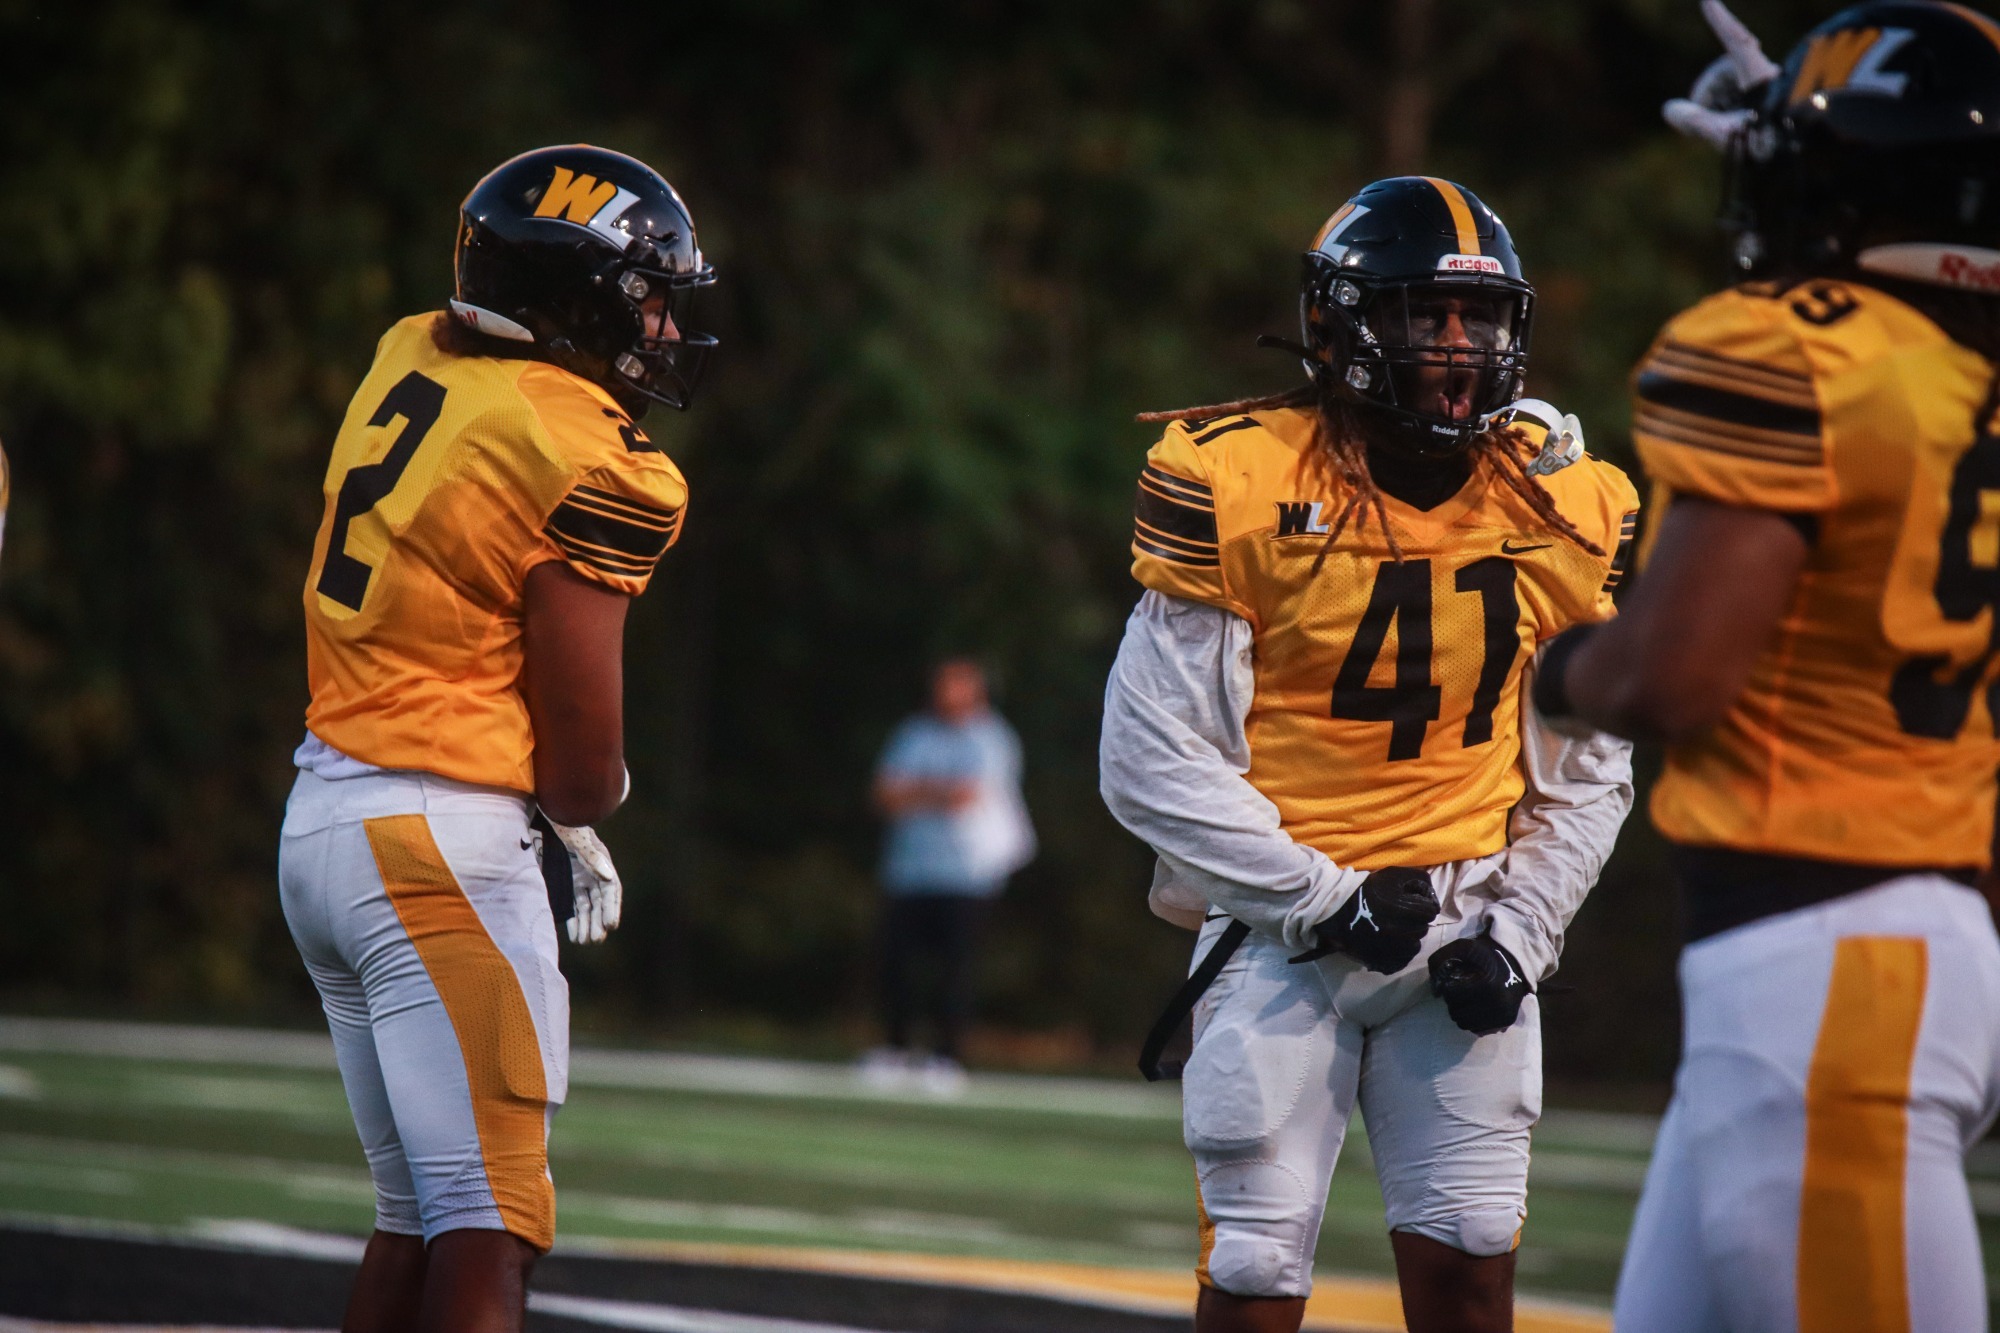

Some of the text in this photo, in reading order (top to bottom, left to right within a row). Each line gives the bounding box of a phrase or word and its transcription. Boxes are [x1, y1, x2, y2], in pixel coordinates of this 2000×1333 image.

[533, 165, 642, 251] WL
[1448, 259, 1499, 272] Riddell
[602, 407, 660, 453] 2
[1432, 424, 1460, 437] Riddell
[316, 370, 448, 612] 2
[1276, 501, 1330, 536] WL
[1890, 433, 2000, 743] 9
[1331, 556, 1521, 762] 41
